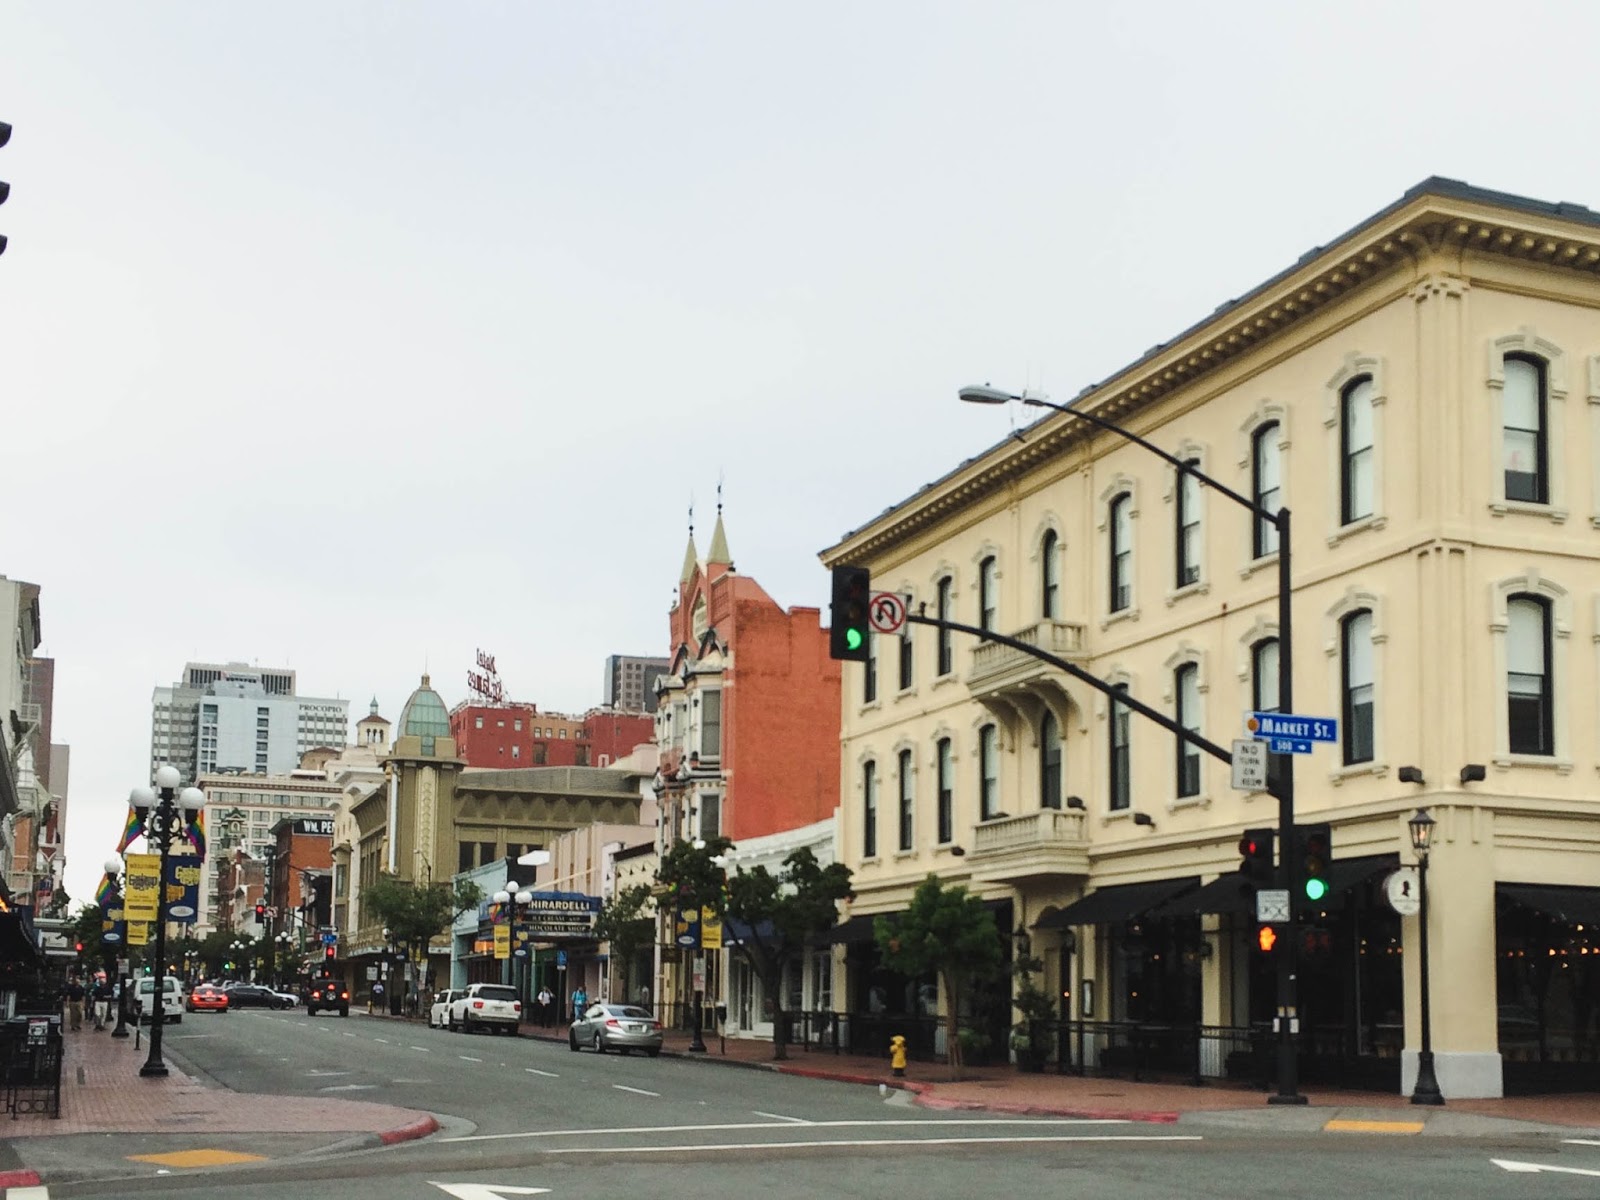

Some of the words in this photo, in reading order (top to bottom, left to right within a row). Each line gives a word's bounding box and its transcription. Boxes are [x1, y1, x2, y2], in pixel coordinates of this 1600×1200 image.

[299, 704, 343, 713] PROCOPIO
[1261, 718, 1310, 736] MARKET
[1241, 745, 1259, 755] NO
[528, 900, 590, 911] HIRARDELLI
[528, 923, 565, 932] HOCOLATE
[567, 924, 587, 932] SHOP
